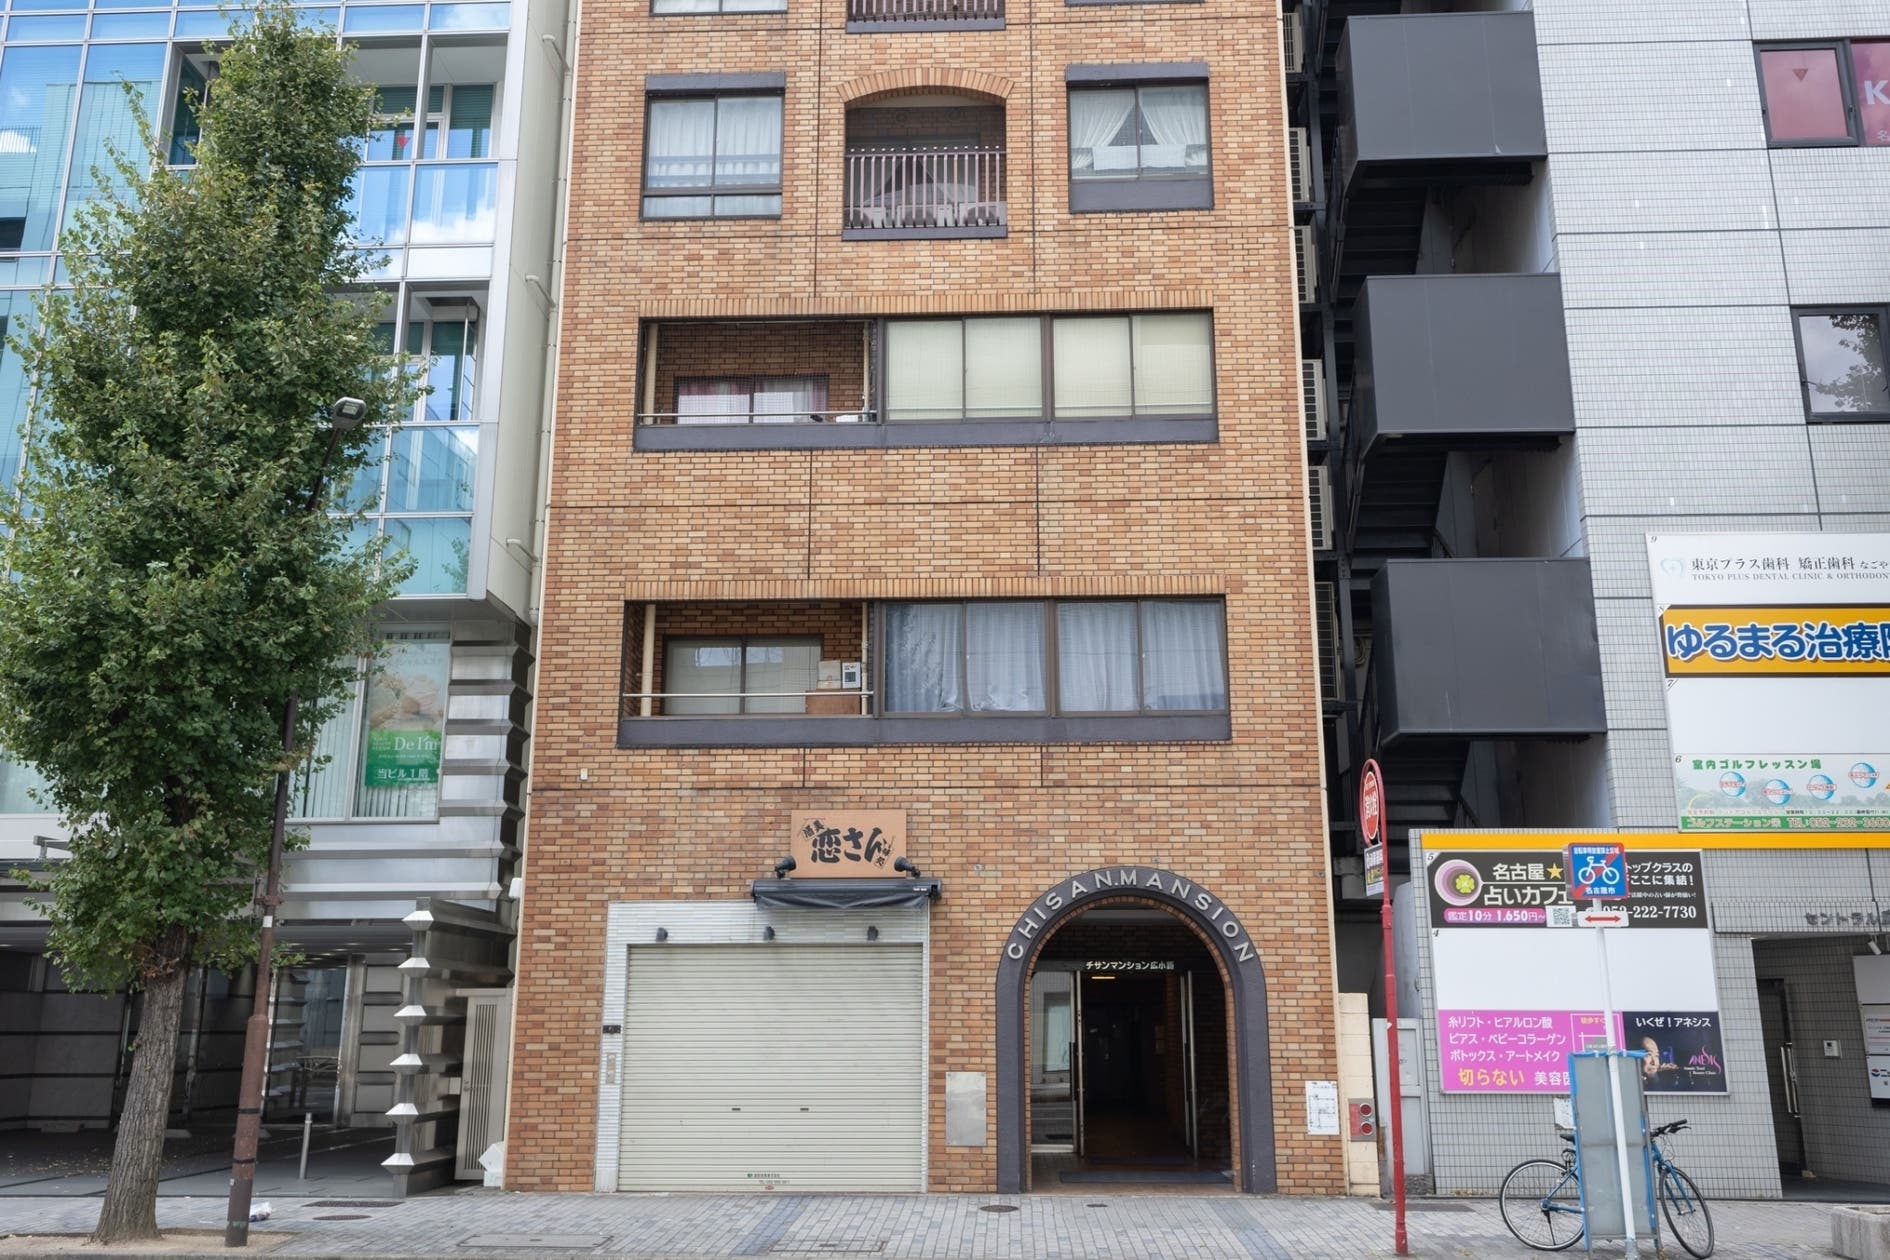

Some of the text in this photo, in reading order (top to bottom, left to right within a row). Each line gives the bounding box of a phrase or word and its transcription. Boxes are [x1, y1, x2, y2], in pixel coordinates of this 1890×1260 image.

[1691, 556, 1888, 571] 東京プラス歯科 矯正歯科 なごや
[1692, 573, 1724, 581] TOKYO
[1727, 573, 1750, 581] PLUS
[1753, 573, 1789, 581] DENTAL
[1837, 572, 1890, 580] ORTHODON
[1692, 759, 1821, 770] 室内ゴルフレッスン場
[811, 826, 883, 863] 恋さん
[1427, 852, 1434, 861] 5
[1492, 863, 1546, 881] 名古屋
[1625, 862, 1694, 873] トップクラスの
[1626, 874, 1694, 886] ここに集結!
[1484, 886, 1574, 906] 占いカフェ
[1585, 886, 1616, 895] 名古屋市
[1448, 910, 1492, 921] 鑑定10分
[1448, 1016, 1553, 1029] 糸リフト・ヒアルロン酸
[1449, 1033, 1566, 1045] ピアス・ベビーコラーゲン
[1450, 1050, 1560, 1062] ボトックス・アートメイク
[1458, 1068, 1525, 1086] 切らない
